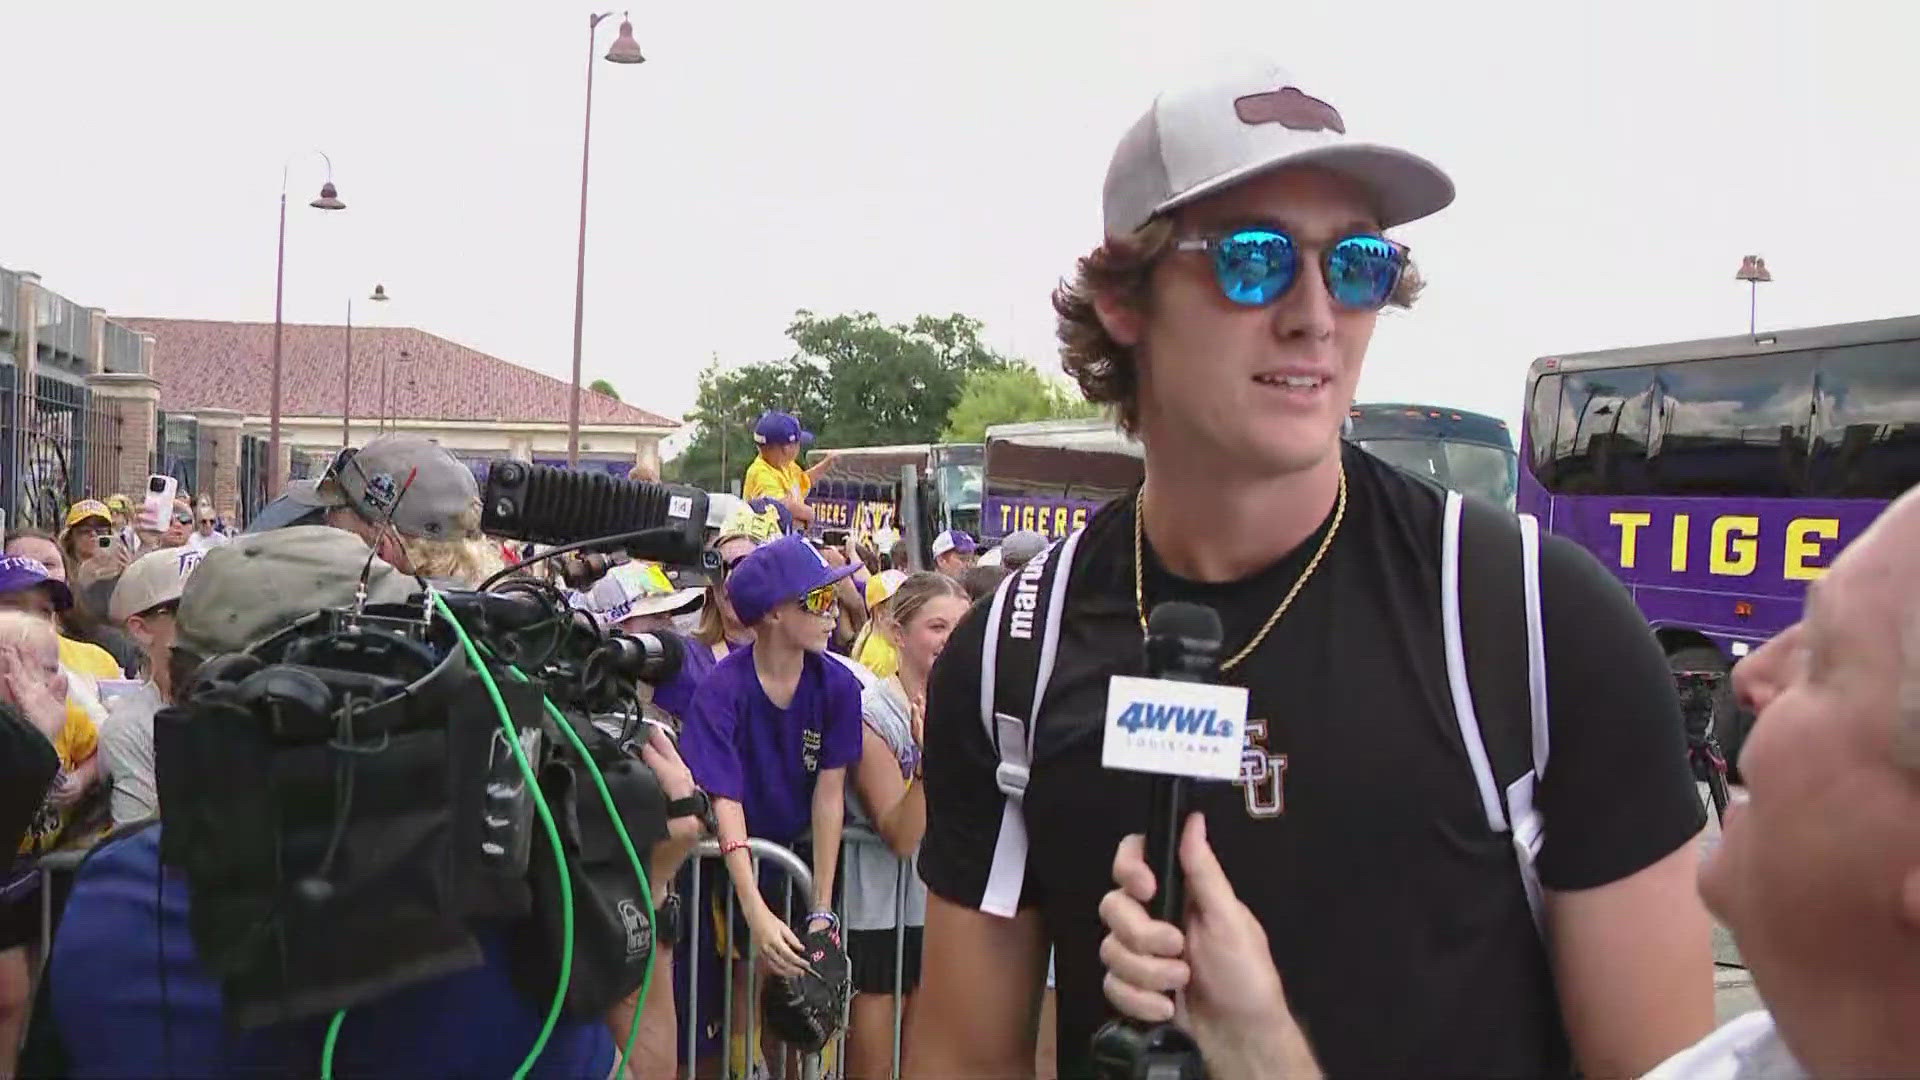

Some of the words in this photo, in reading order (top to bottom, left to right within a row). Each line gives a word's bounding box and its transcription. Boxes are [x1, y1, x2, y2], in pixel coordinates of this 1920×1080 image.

[674, 499, 688, 513] 14
[811, 501, 848, 526] TIGERS
[1000, 504, 1088, 539] TIGERS
[1609, 512, 1840, 581] TIGE
[1117, 702, 1218, 738] 4WWL
